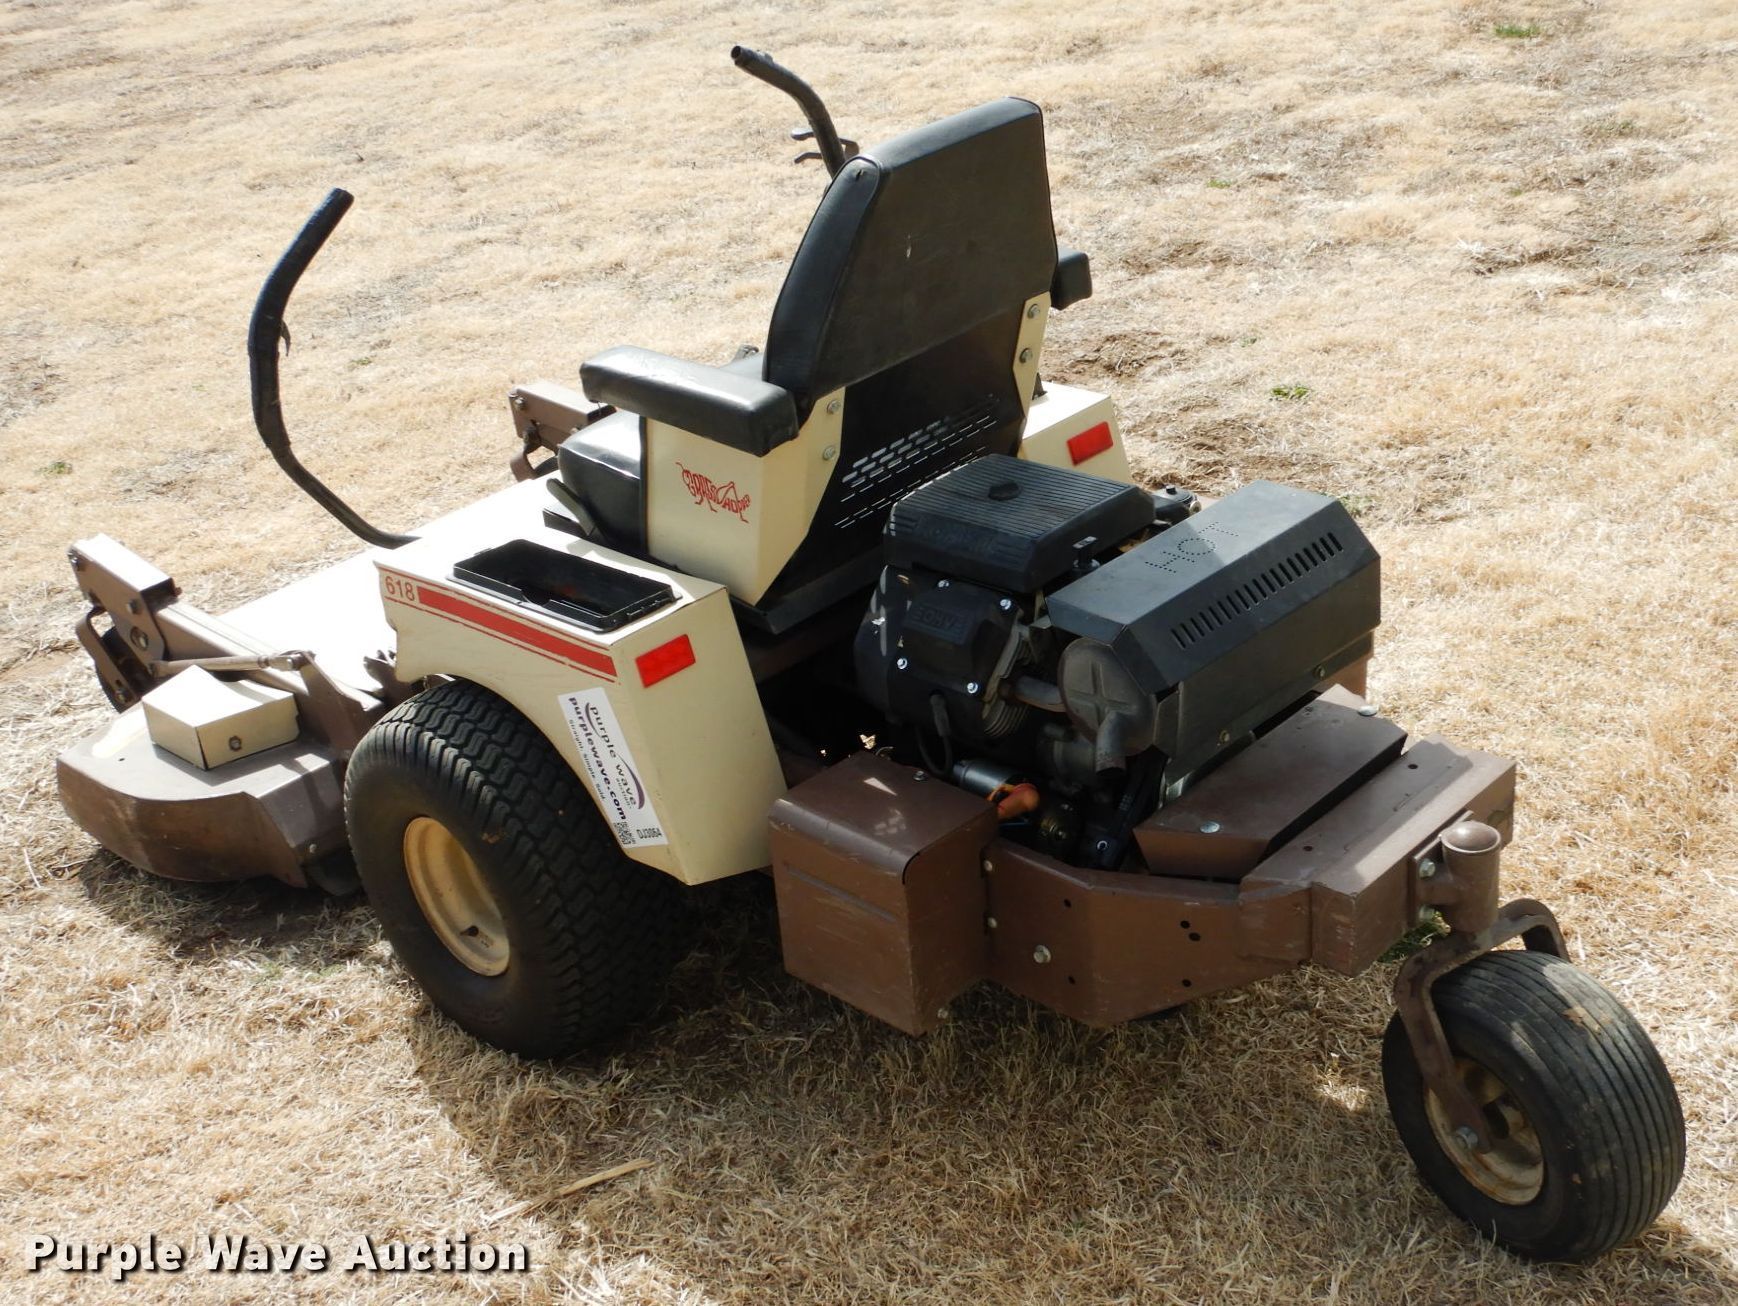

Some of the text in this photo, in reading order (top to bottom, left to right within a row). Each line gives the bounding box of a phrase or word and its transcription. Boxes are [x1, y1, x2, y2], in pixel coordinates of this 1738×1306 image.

[1145, 521, 1239, 574] HOT
[385, 575, 415, 601] 618
[569, 697, 627, 820] purplewave.com
[590, 706, 636, 806] purple wave
